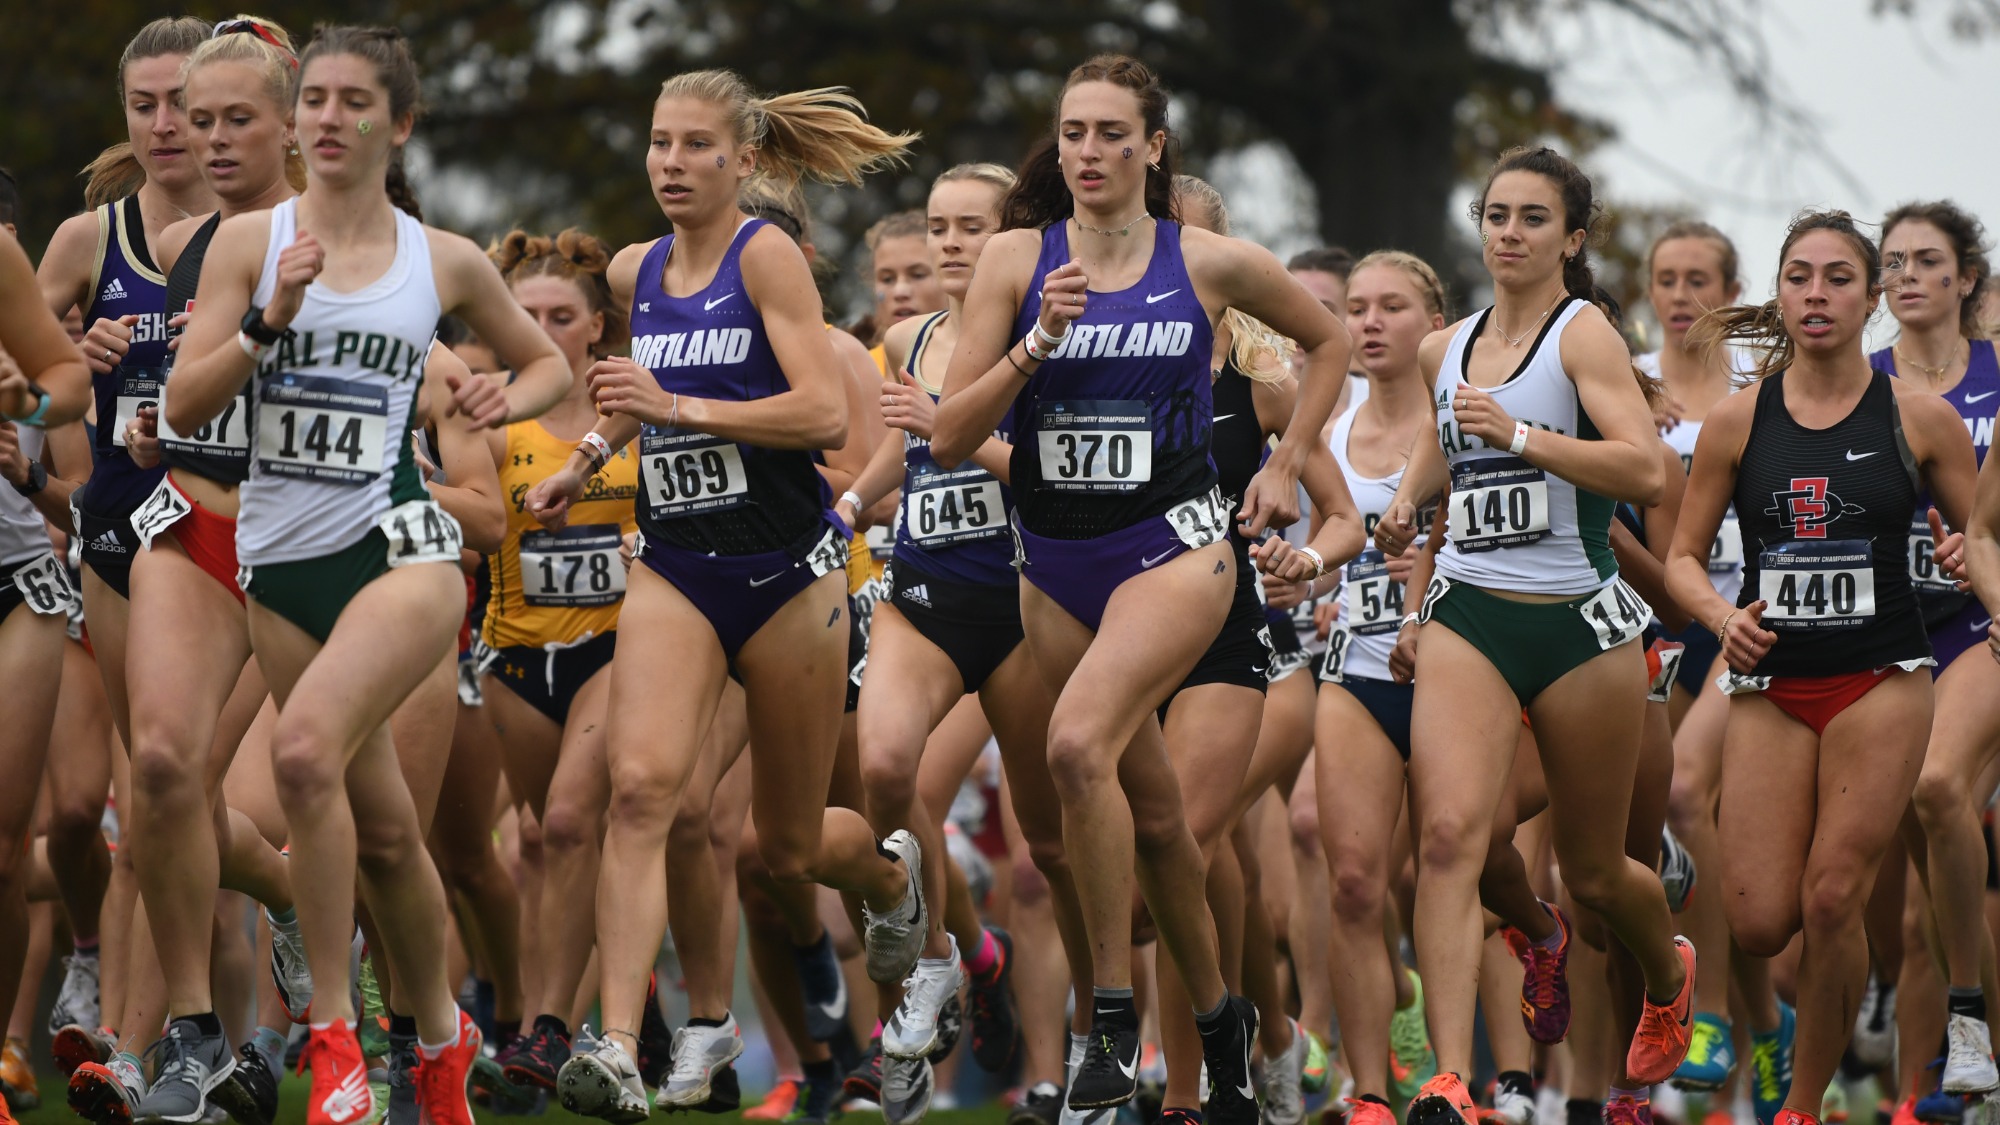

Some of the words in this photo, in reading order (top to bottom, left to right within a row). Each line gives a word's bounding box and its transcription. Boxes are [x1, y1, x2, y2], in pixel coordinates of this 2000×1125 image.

[102, 291, 127, 301] adidas
[130, 312, 167, 344] SH
[1048, 321, 1194, 360] ORTLAND
[332, 331, 420, 382] POLY
[279, 409, 364, 465] 144
[1098, 416, 1146, 424] CHAMPIONSHIPS
[653, 449, 729, 502] 369
[1056, 433, 1132, 479] 370
[919, 486, 989, 534] 645
[1463, 486, 1531, 536] 140
[91, 541, 127, 554] adidas
[1822, 554, 1867, 562] CHAMPIONSHIPS
[538, 552, 611, 594] 178
[901, 590, 933, 609] adidas
[1776, 572, 1856, 616] 440
[1816, 619, 1842, 627] NOVEMBER
